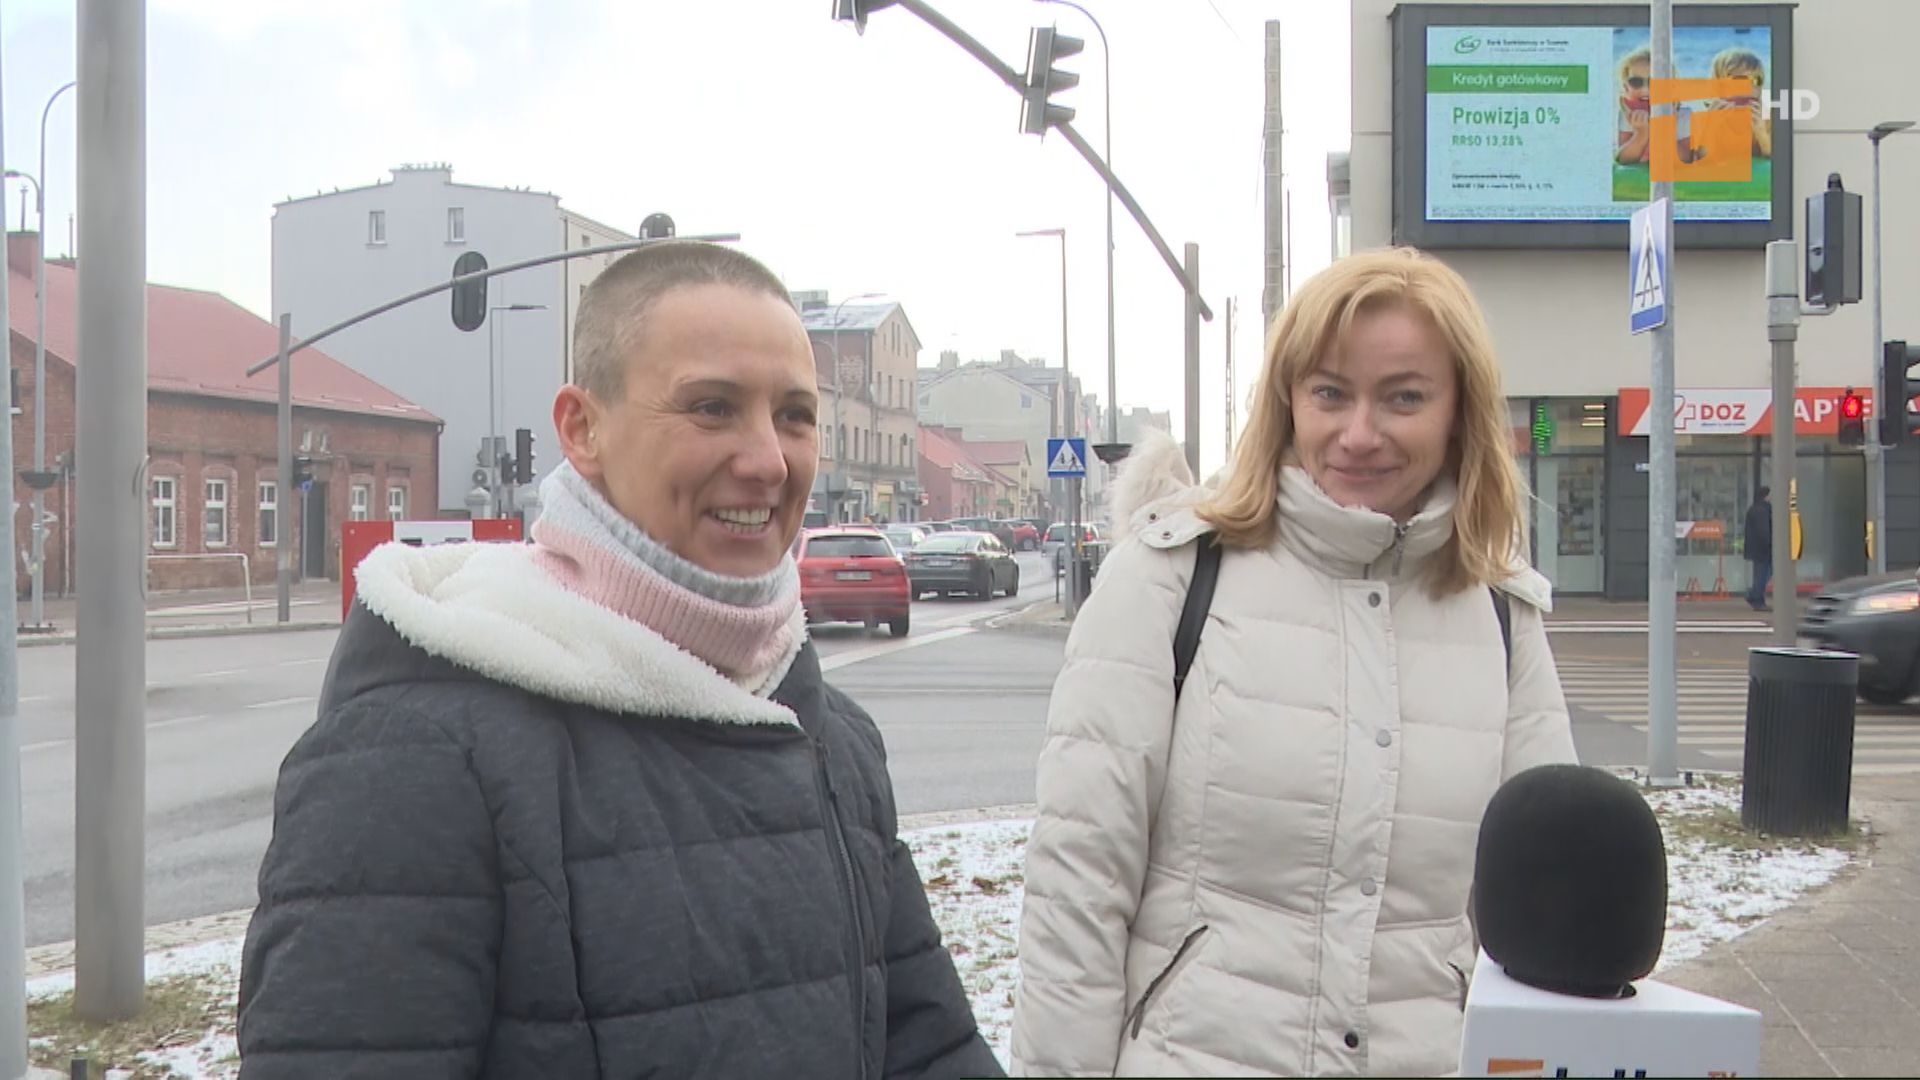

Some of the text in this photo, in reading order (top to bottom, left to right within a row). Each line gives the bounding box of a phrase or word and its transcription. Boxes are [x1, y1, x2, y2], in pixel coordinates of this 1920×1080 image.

[1453, 72, 1568, 87] Kredyt gotówkowy
[1453, 107, 1560, 129] Prowizja 0%
[1452, 135, 1482, 146] RRSO
[1700, 403, 1745, 420] DOZ
